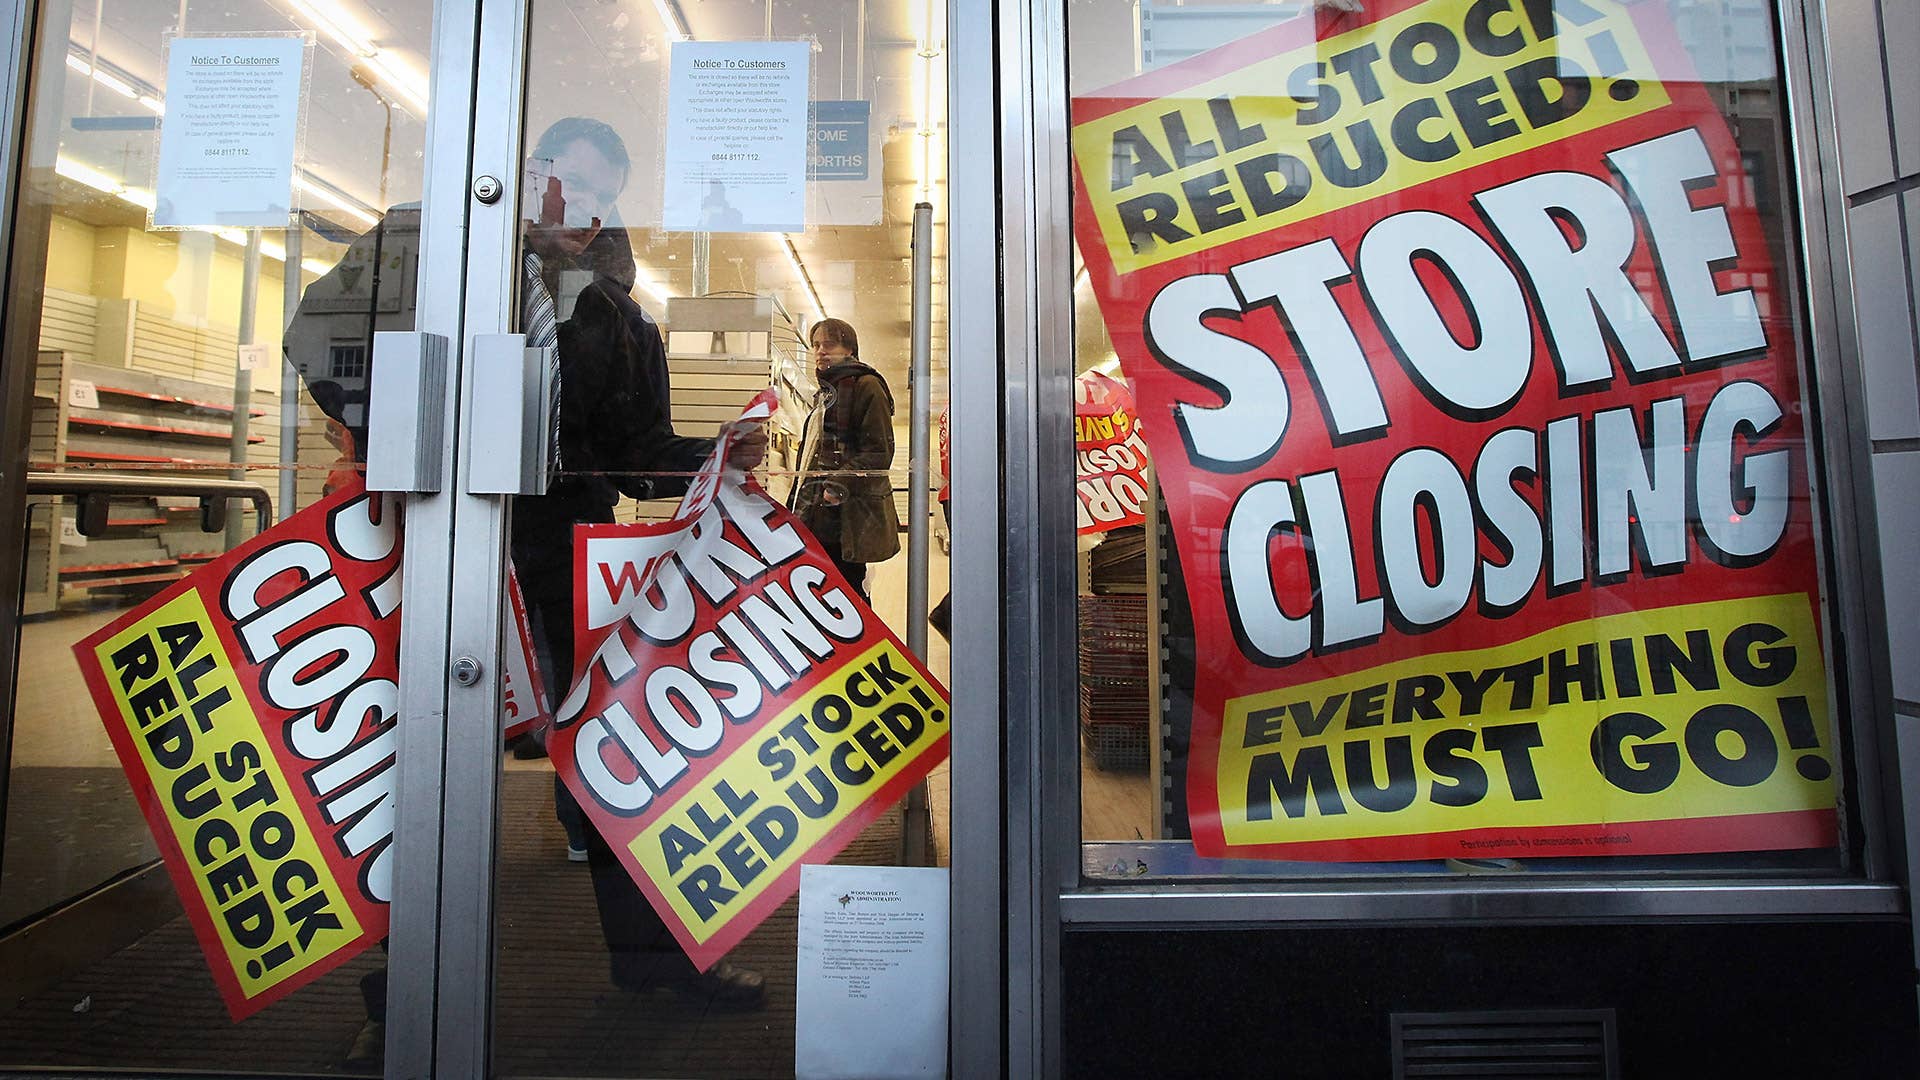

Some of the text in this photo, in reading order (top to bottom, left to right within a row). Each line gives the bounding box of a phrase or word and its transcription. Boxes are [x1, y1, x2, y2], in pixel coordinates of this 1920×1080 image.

[192, 56, 280, 65] Notice To Customers
[693, 60, 786, 69] Notice To Customers
[1110, 94, 1266, 192] ALL
[1116, 29, 1640, 255] REDUCED!
[1143, 127, 1771, 473] STORE
[1222, 380, 1791, 671] CLOSING
[155, 620, 343, 955] ALL STOCK
[573, 565, 865, 818] CLOSING
[656, 650, 913, 878] ALL STOCK
[1242, 622, 1797, 748] EVERYTHING
[1244, 695, 1833, 822] MUST GO!
[110, 633, 296, 980] REDUCED!
[678, 685, 946, 925] REDUCED!
[1460, 839, 1516, 848] Participation
[1519, 836, 1530, 848] by
[1594, 833, 1632, 845] optional
